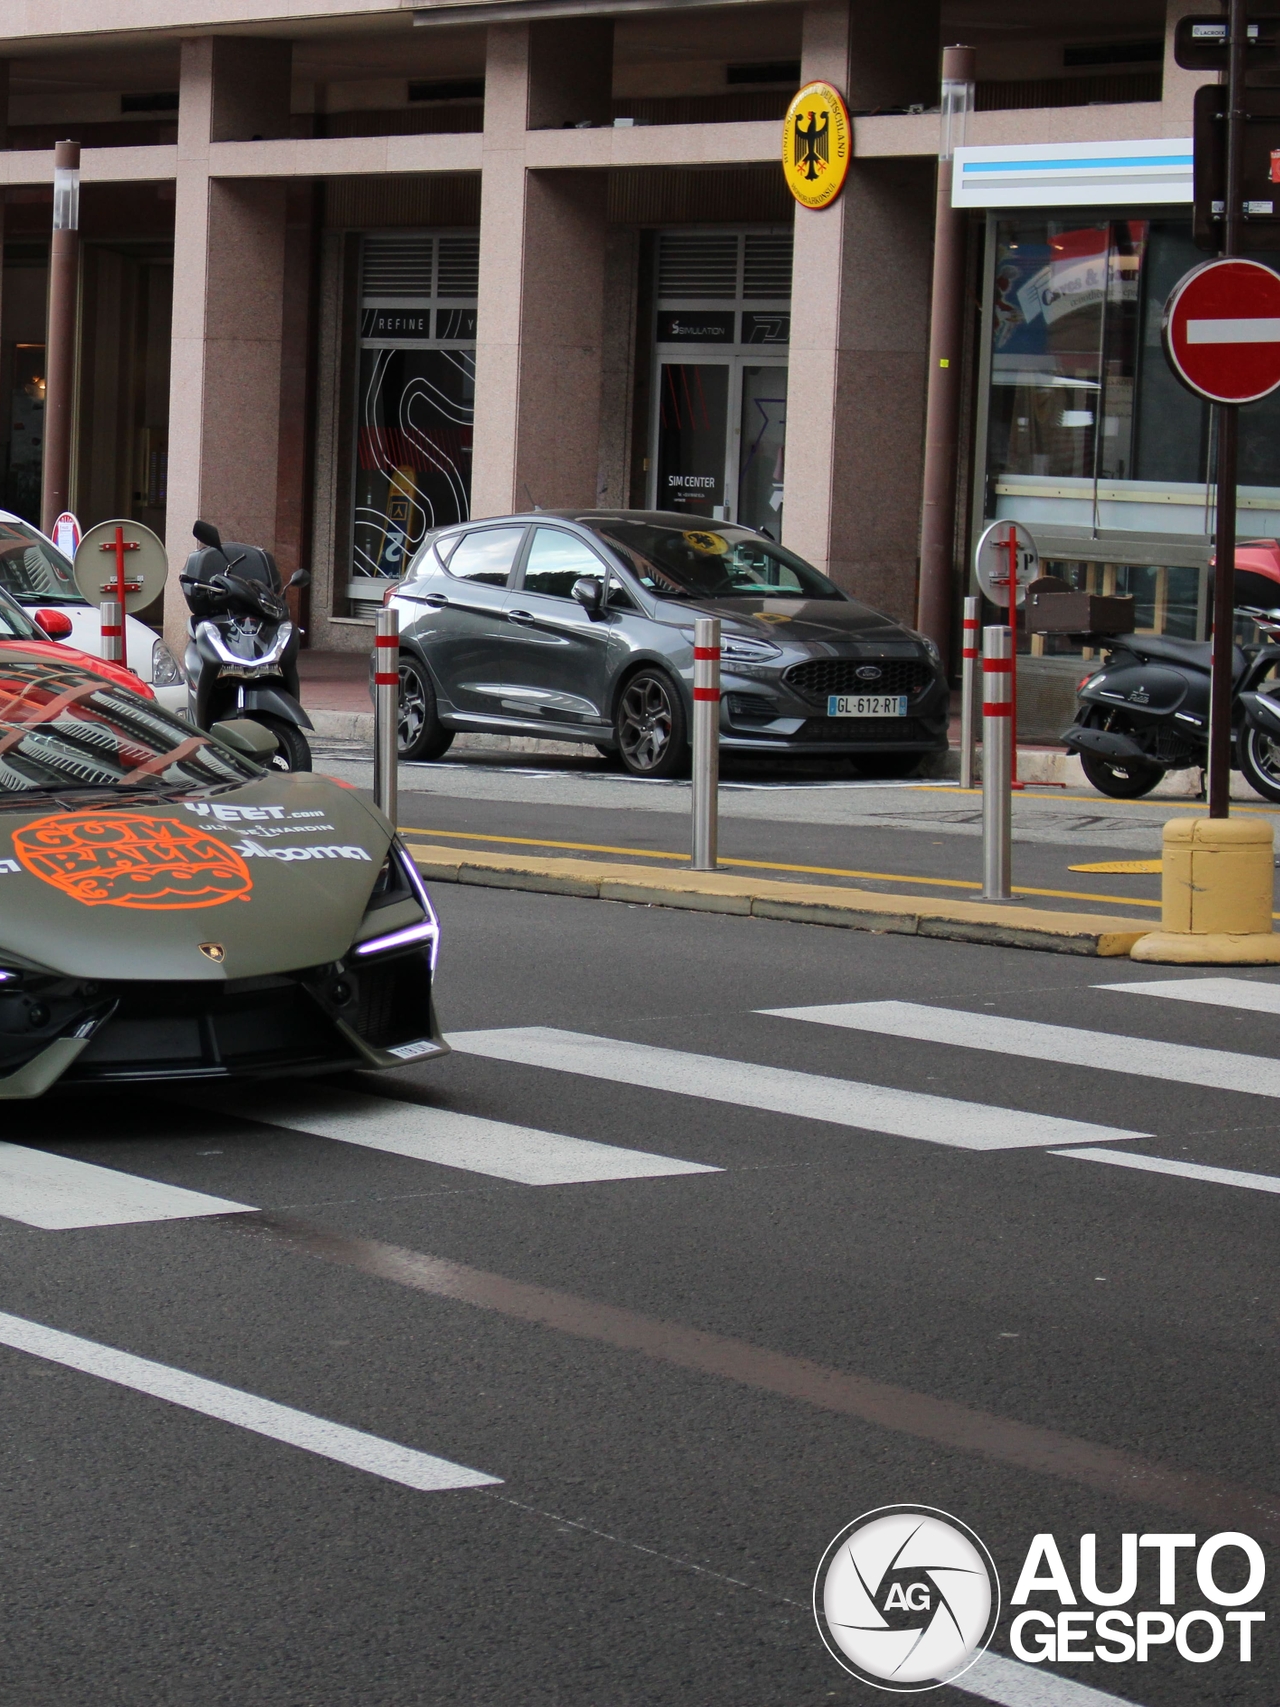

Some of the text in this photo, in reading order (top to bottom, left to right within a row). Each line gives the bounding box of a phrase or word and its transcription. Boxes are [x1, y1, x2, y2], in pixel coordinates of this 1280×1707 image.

[819, 87, 846, 158] DEUTSCHLAND
[378, 318, 424, 330] REFINE
[668, 475, 715, 488] SIM CENTER
[837, 698, 898, 714] GL-612-RT
[269, 823, 336, 835] NARDIN
[23, 842, 243, 880] BALL
